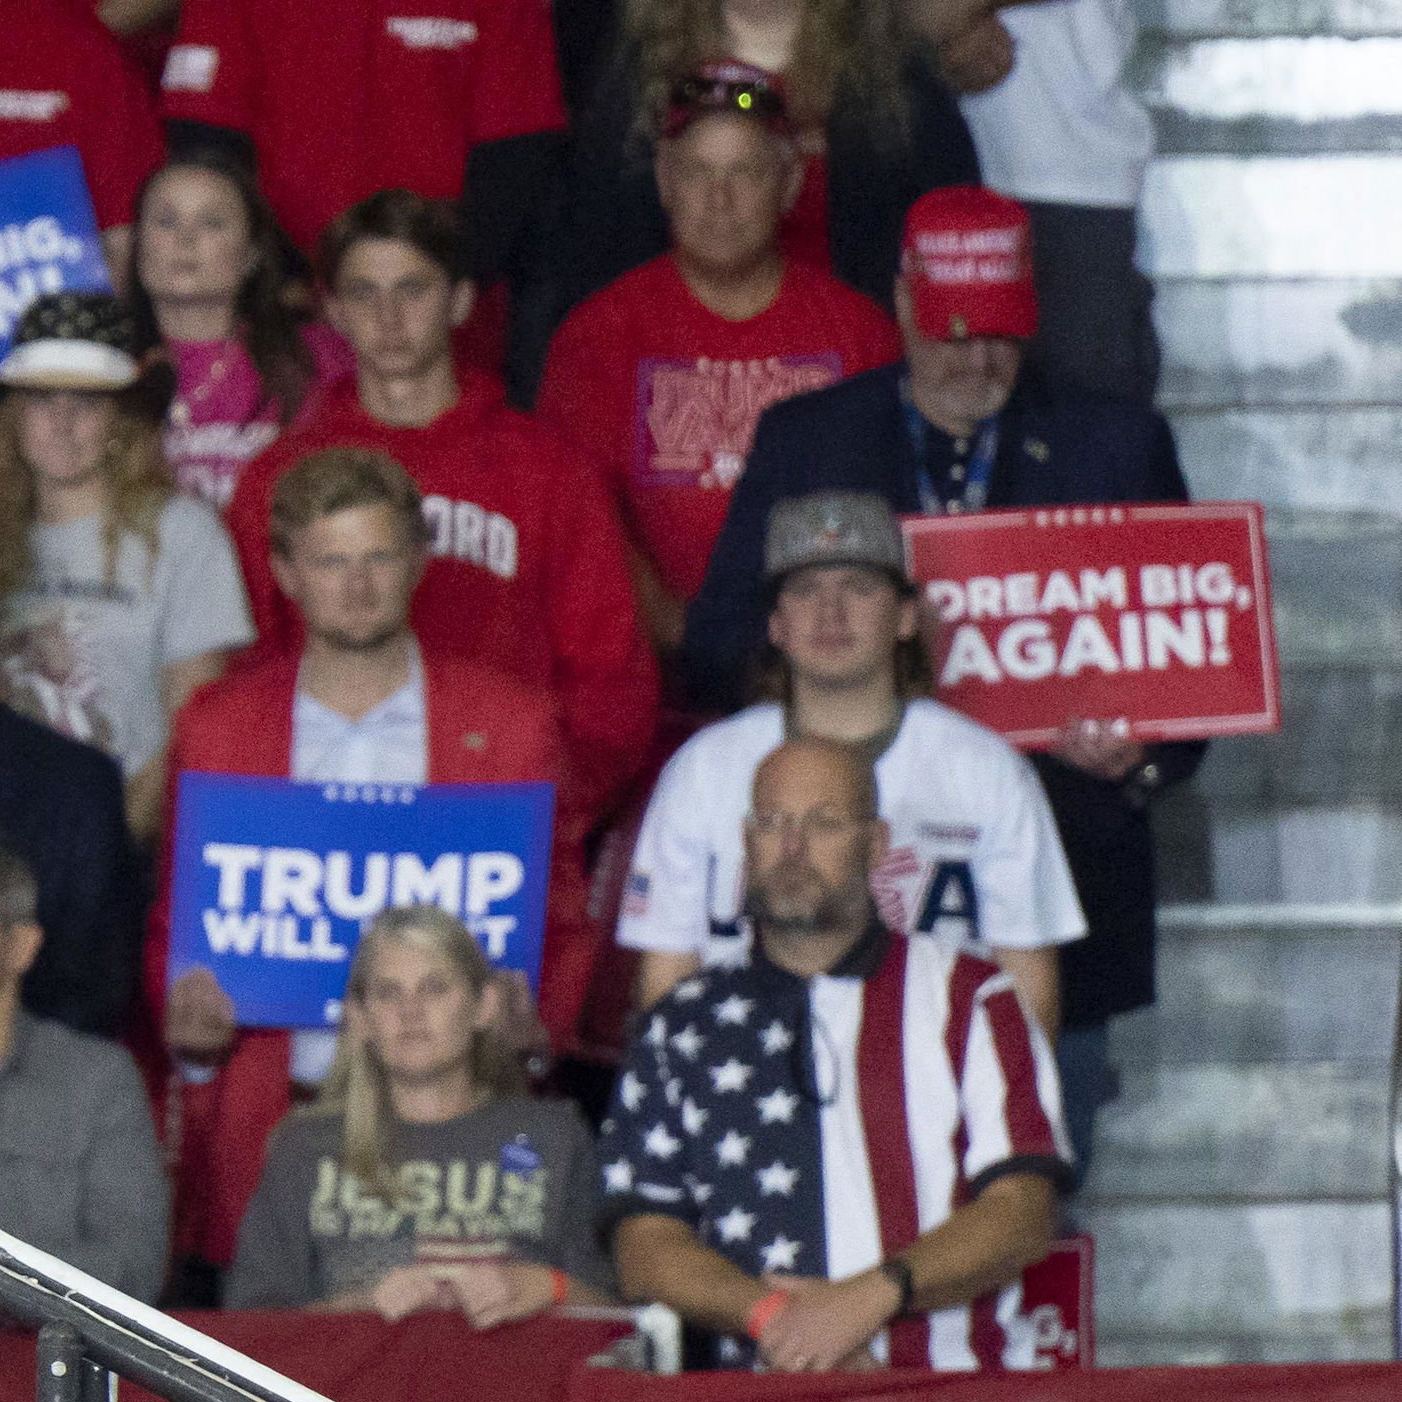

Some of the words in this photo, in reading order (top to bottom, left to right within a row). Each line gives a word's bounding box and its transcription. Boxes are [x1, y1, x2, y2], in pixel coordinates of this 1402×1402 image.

[420, 493, 518, 578] ORD
[924, 565, 1128, 625] DREAM
[1138, 560, 1253, 612] BIG,
[937, 605, 1233, 688] AGAIN!
[202, 841, 526, 919] TRUMP
[202, 908, 346, 961] WILL
